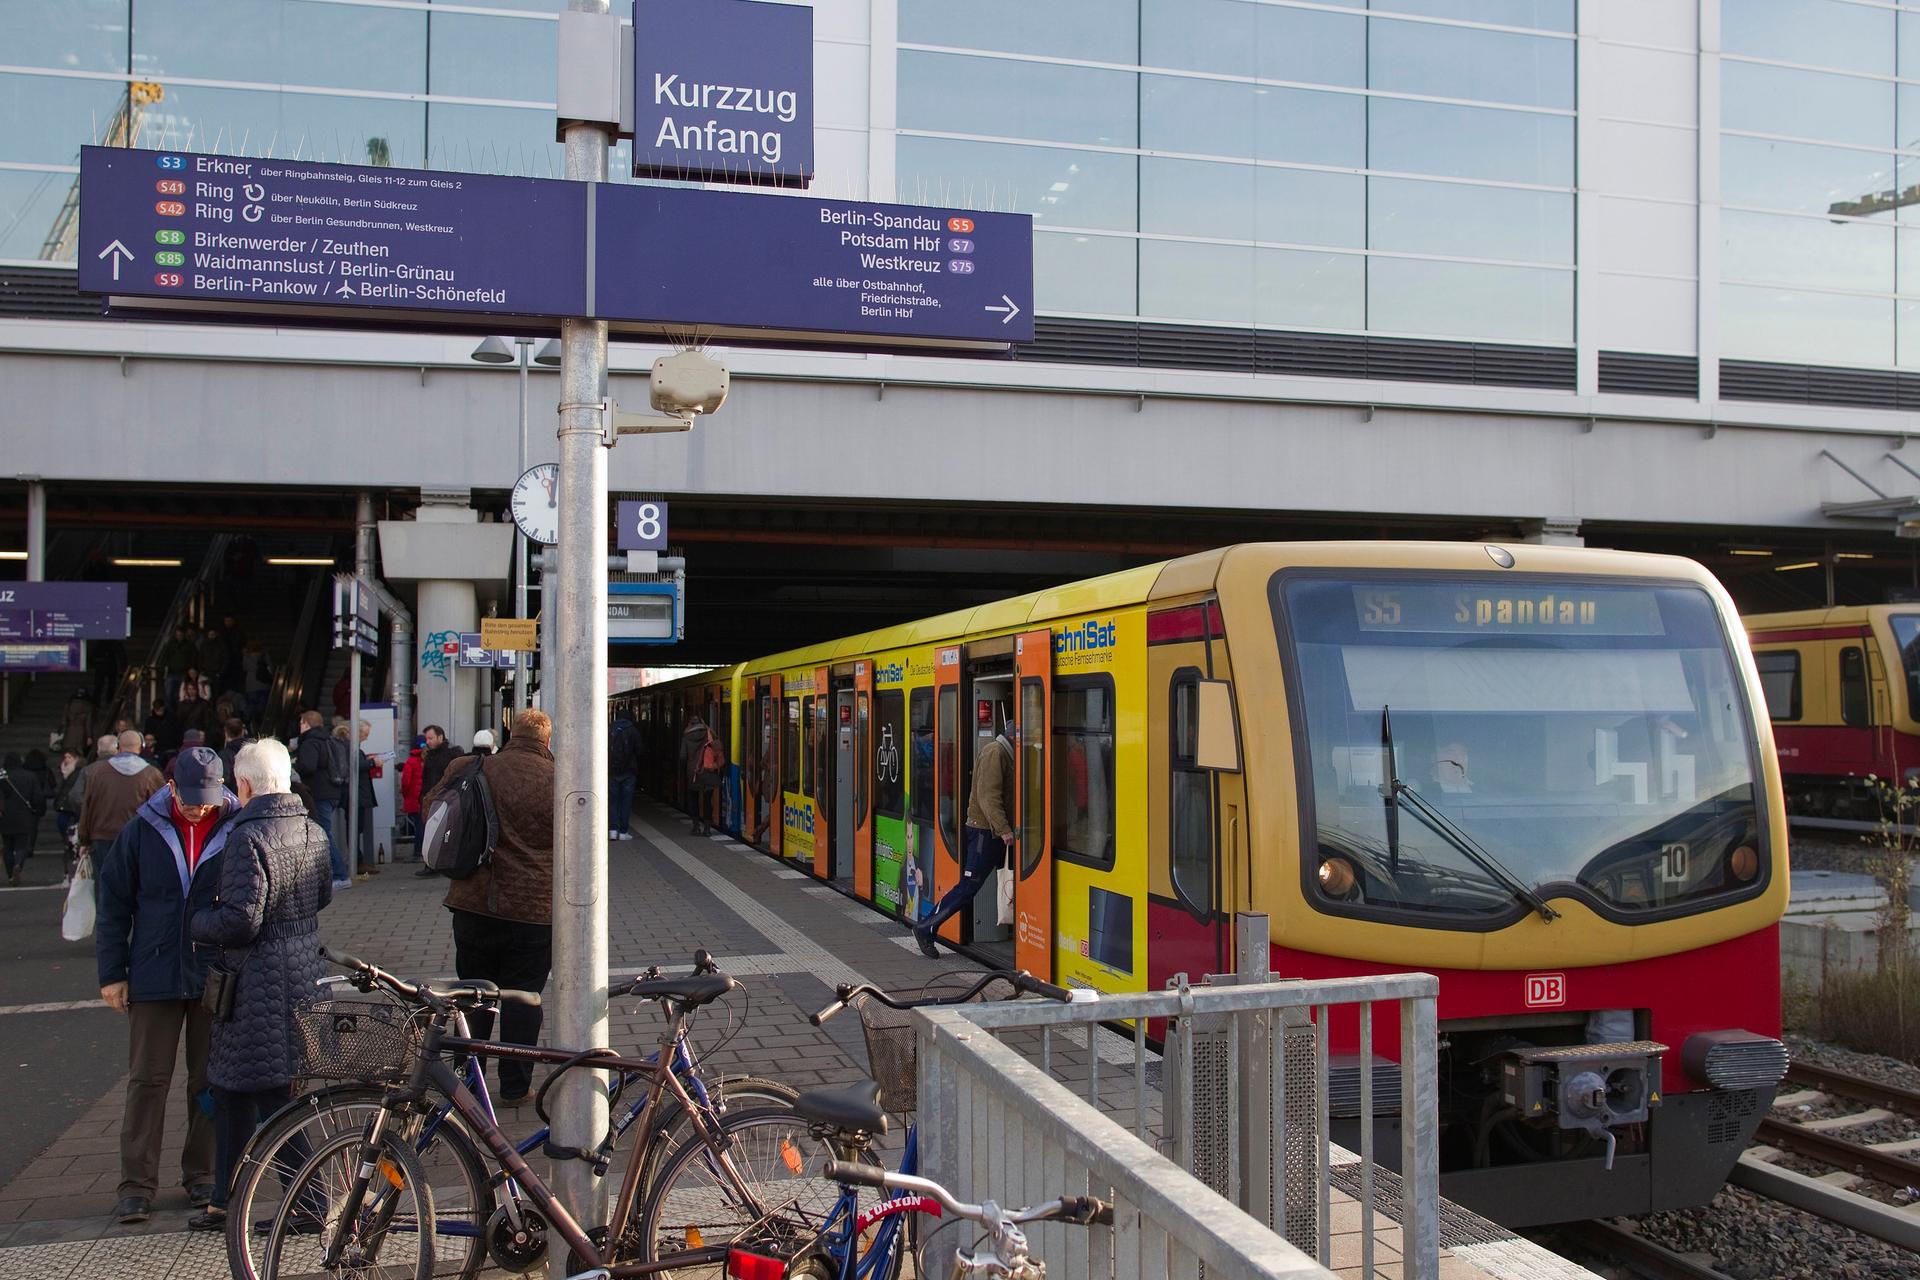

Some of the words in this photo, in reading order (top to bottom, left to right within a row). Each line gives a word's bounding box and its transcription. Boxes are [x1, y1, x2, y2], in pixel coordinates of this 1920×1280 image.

[654, 73, 797, 122] Kurzzug
[655, 117, 782, 163] Anfang
[162, 157, 181, 168] S3
[196, 157, 252, 175] Erkner
[260, 168, 283, 177] über
[285, 170, 355, 183] Ringbahnsteig,
[358, 174, 383, 184] Gleis
[384, 177, 406, 186] 11-12
[408, 179, 428, 188] zum
[430, 179, 454, 189] Gleis
[456, 181, 462, 190] 2
[160, 182, 183, 193] S41
[196, 182, 234, 201] Ring
[271, 193, 293, 203] über
[295, 194, 341, 206] Neukölln,
[343, 198, 371, 208] Berlin
[374, 199, 418, 211] Südkreuz
[159, 204, 182, 215] S42
[195, 203, 233, 222] Ring
[271, 214, 293, 224] über
[295, 215, 323, 226] Berlin
[326, 217, 403, 231] Gesundbrunnen,
[405, 222, 454, 234] Westkreuz
[820, 208, 941, 231] Berlin-Spandau
[953, 219, 969, 231] S5
[161, 232, 179, 243] S8
[195, 231, 306, 252] Birkenwerder
[322, 239, 389, 257] Zeuthen
[841, 231, 908, 250] Potsdam
[913, 236, 941, 252] Hbf
[953, 240, 969, 251] S7
[158, 253, 181, 265] S85
[194, 253, 324, 274] Waidmannslust
[340, 261, 454, 282] Berlin-Grünau
[860, 254, 941, 273] Westkreuz
[951, 262, 972, 273] S75
[160, 275, 178, 286] S9
[194, 274, 318, 295] Berlin-Pankow
[361, 283, 506, 304] Berlin-Schönefeld
[813, 277, 833, 287] alle
[836, 278, 860, 289] über
[862, 280, 926, 294] Ostbahnhof,
[861, 293, 942, 308] Friedrichstraße,
[861, 306, 892, 318] Berlin
[895, 307, 913, 318] Hbf
[637, 503, 661, 540] 8
[1364, 592, 1400, 625] S5
[1455, 595, 1597, 627] Spandau
[1662, 845, 1687, 878] 10
[1531, 979, 1561, 1001] DB
[863, 1196, 922, 1222] TONYON
